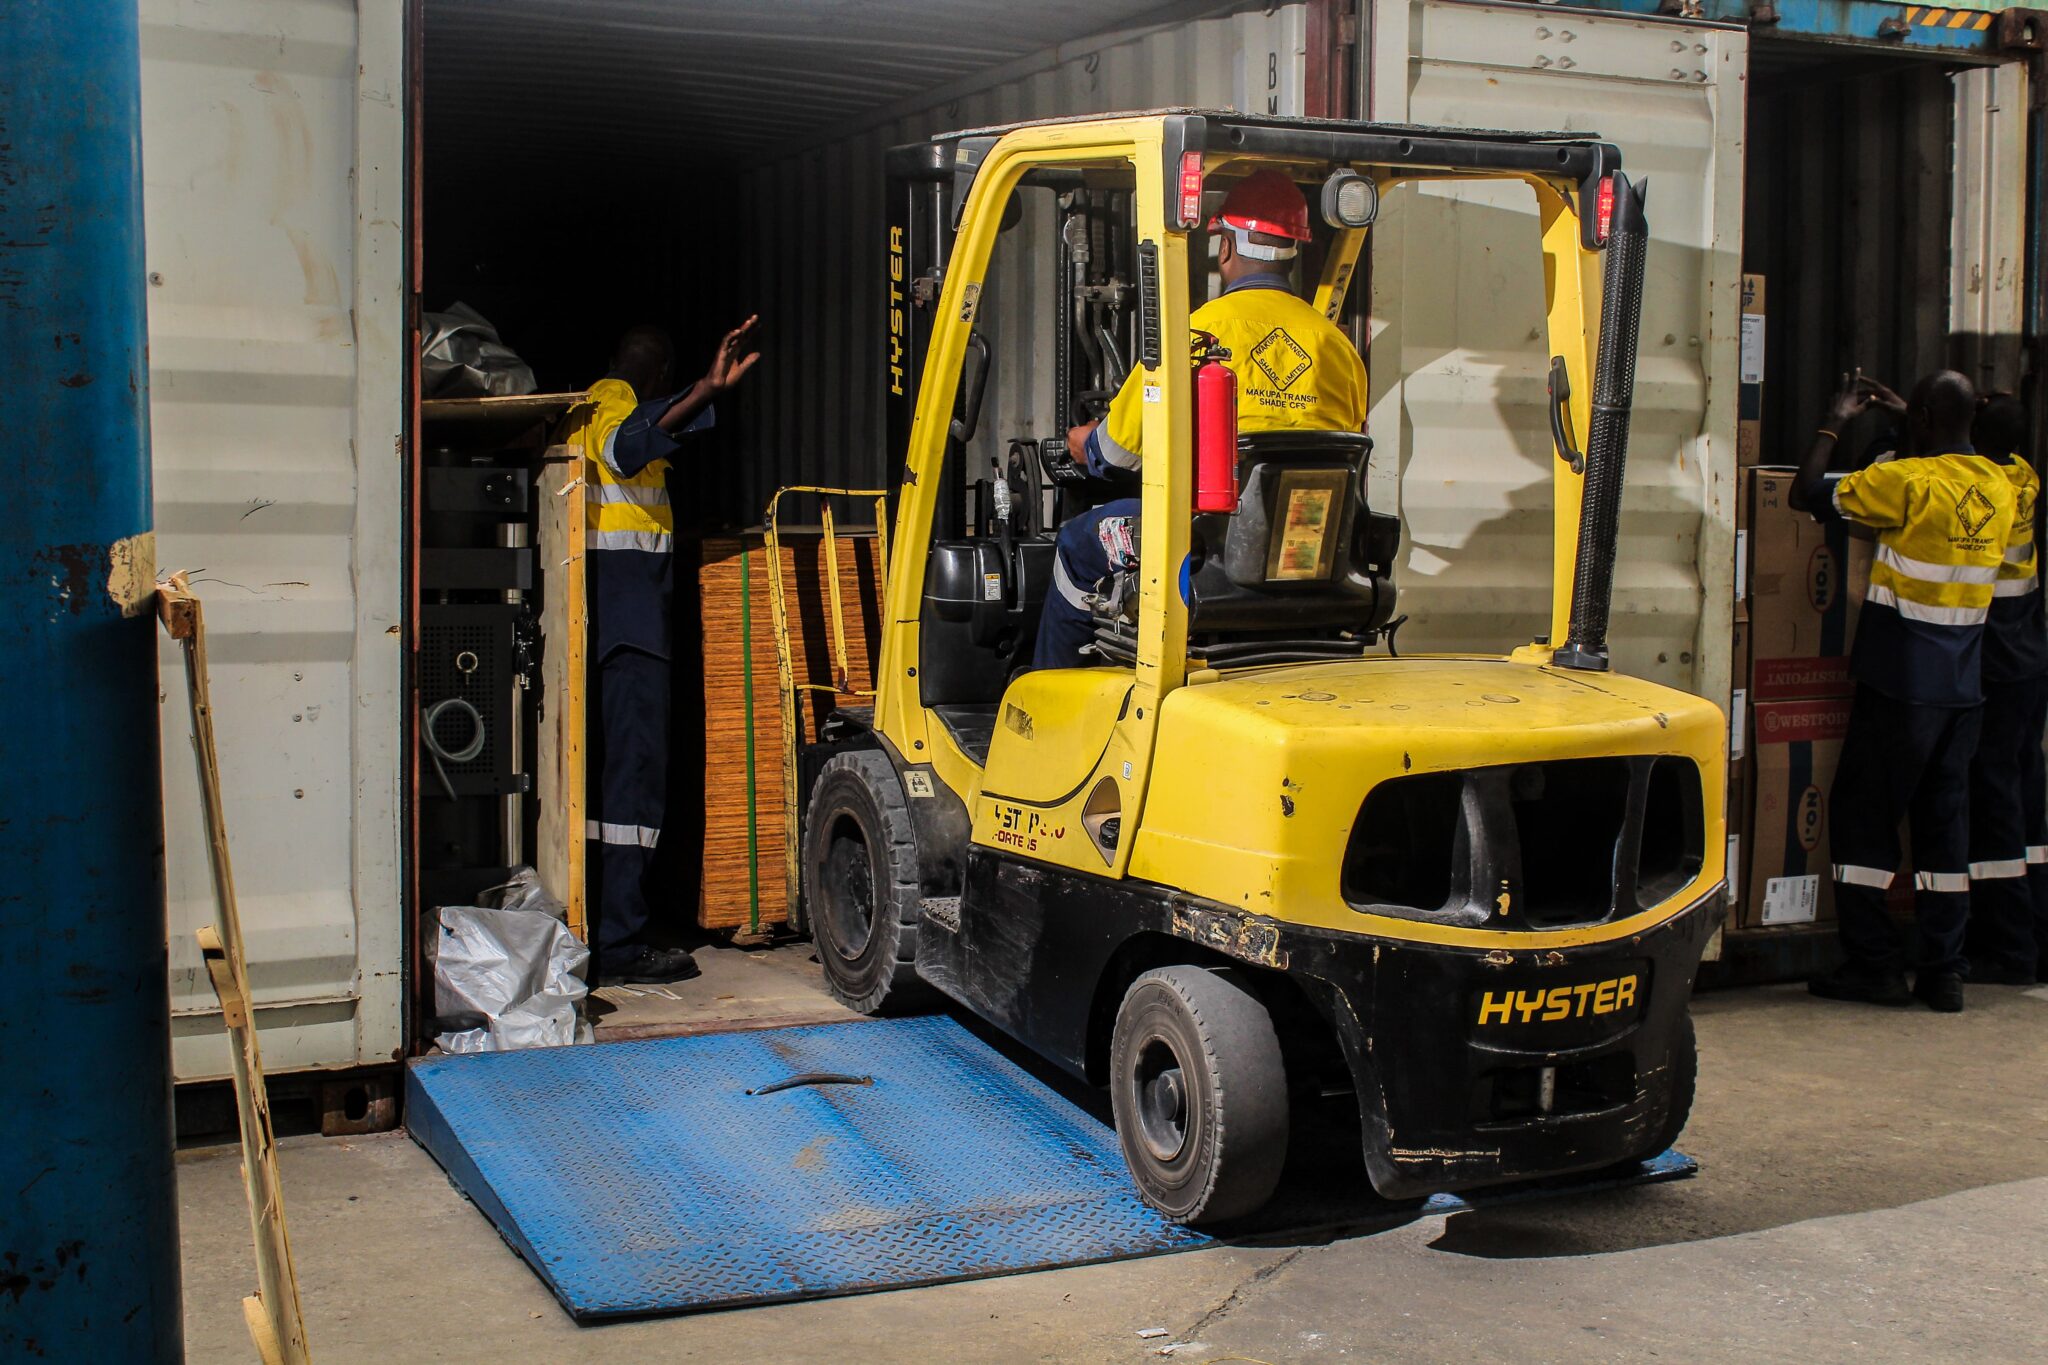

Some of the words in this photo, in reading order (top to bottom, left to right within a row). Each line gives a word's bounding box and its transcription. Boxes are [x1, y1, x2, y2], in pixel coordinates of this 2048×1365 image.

[891, 225, 903, 396] HYSTER
[1255, 332, 1280, 356] MAKUPA
[1281, 333, 1307, 361] TRANSIT
[1258, 358, 1281, 383] SHADE
[1281, 362, 1306, 386] LIMITED
[1246, 388, 1281, 398] MAKUPA
[1283, 392, 1318, 403] TRANSIT
[1259, 397, 1287, 408] SHADE
[1289, 401, 1306, 409] CFS
[1478, 974, 1637, 1025] HYSTER
